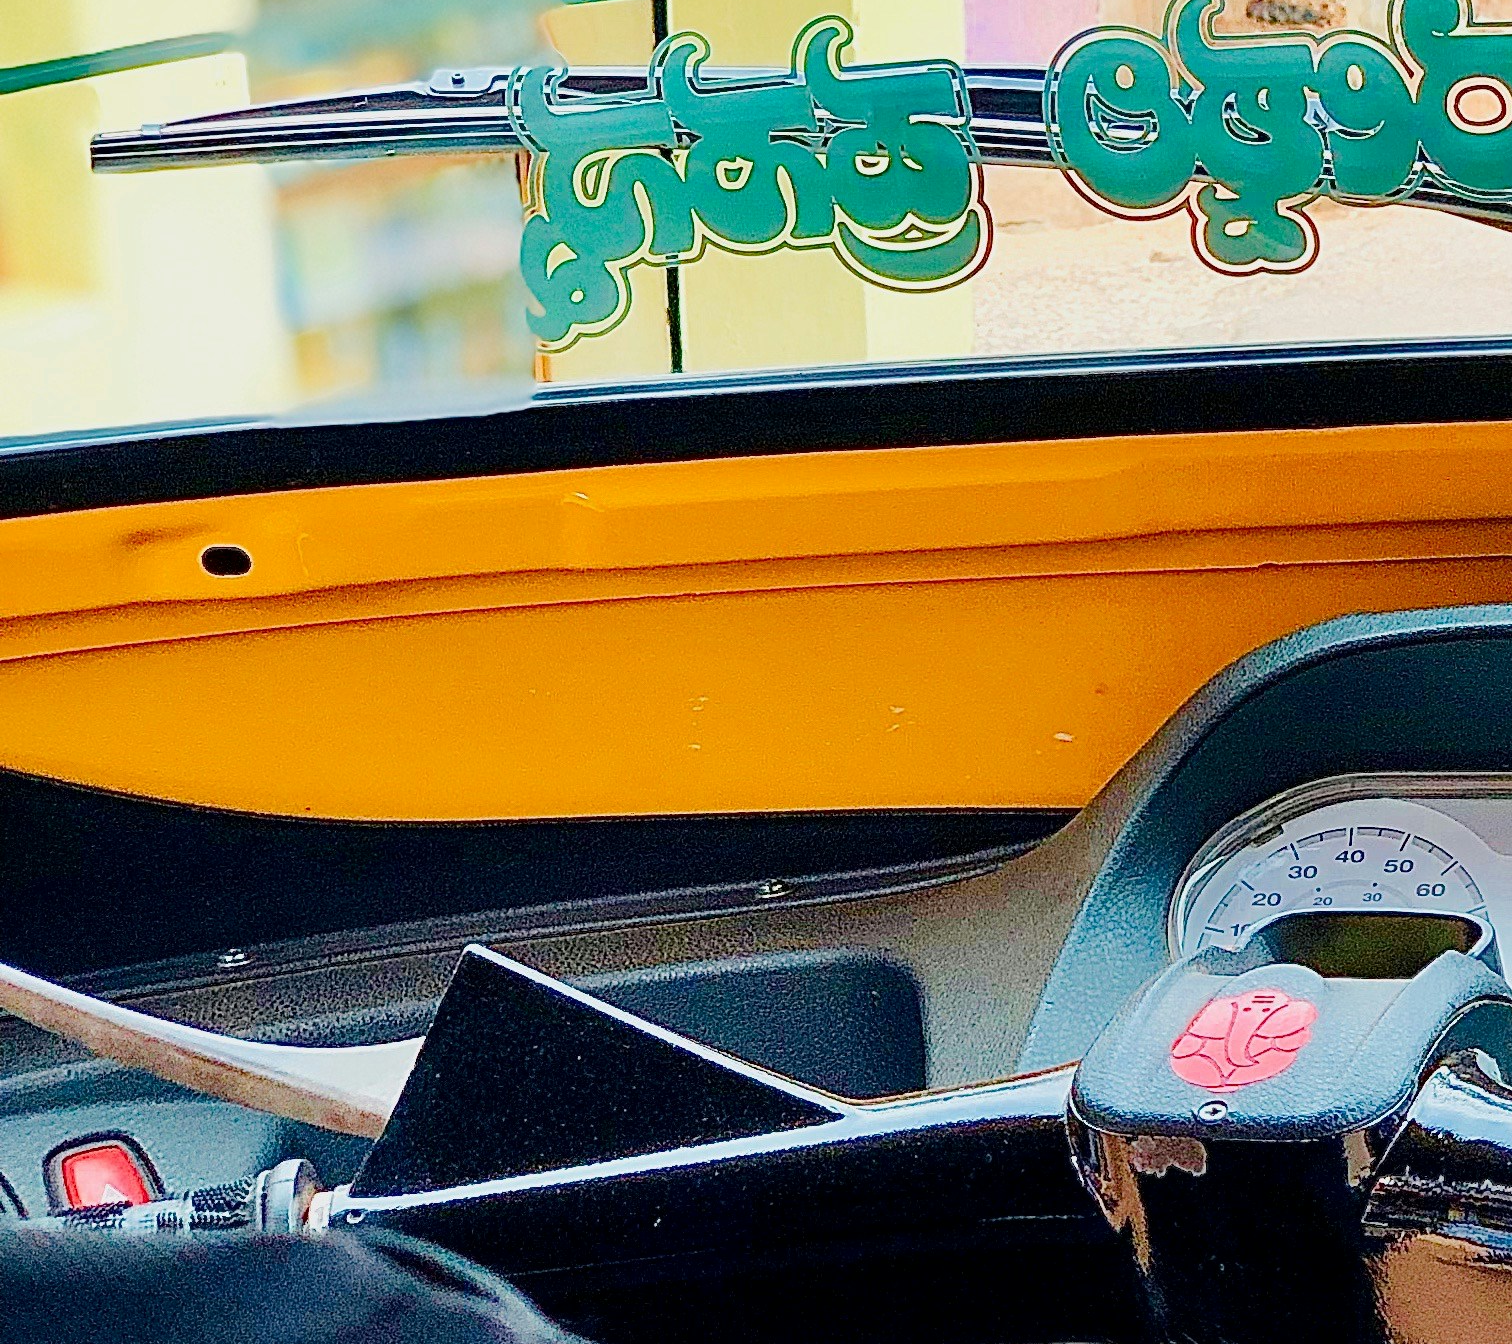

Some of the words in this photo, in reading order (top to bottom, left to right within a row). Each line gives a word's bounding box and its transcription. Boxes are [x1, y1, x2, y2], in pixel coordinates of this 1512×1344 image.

[1252, 892, 1282, 906] 20
[1288, 865, 1318, 879] 30
[1335, 849, 1365, 863] 40
[1383, 859, 1414, 873] 50
[1416, 883, 1446, 897] 60
[1313, 896, 1333, 906] 20
[1362, 892, 1382, 902] 30
